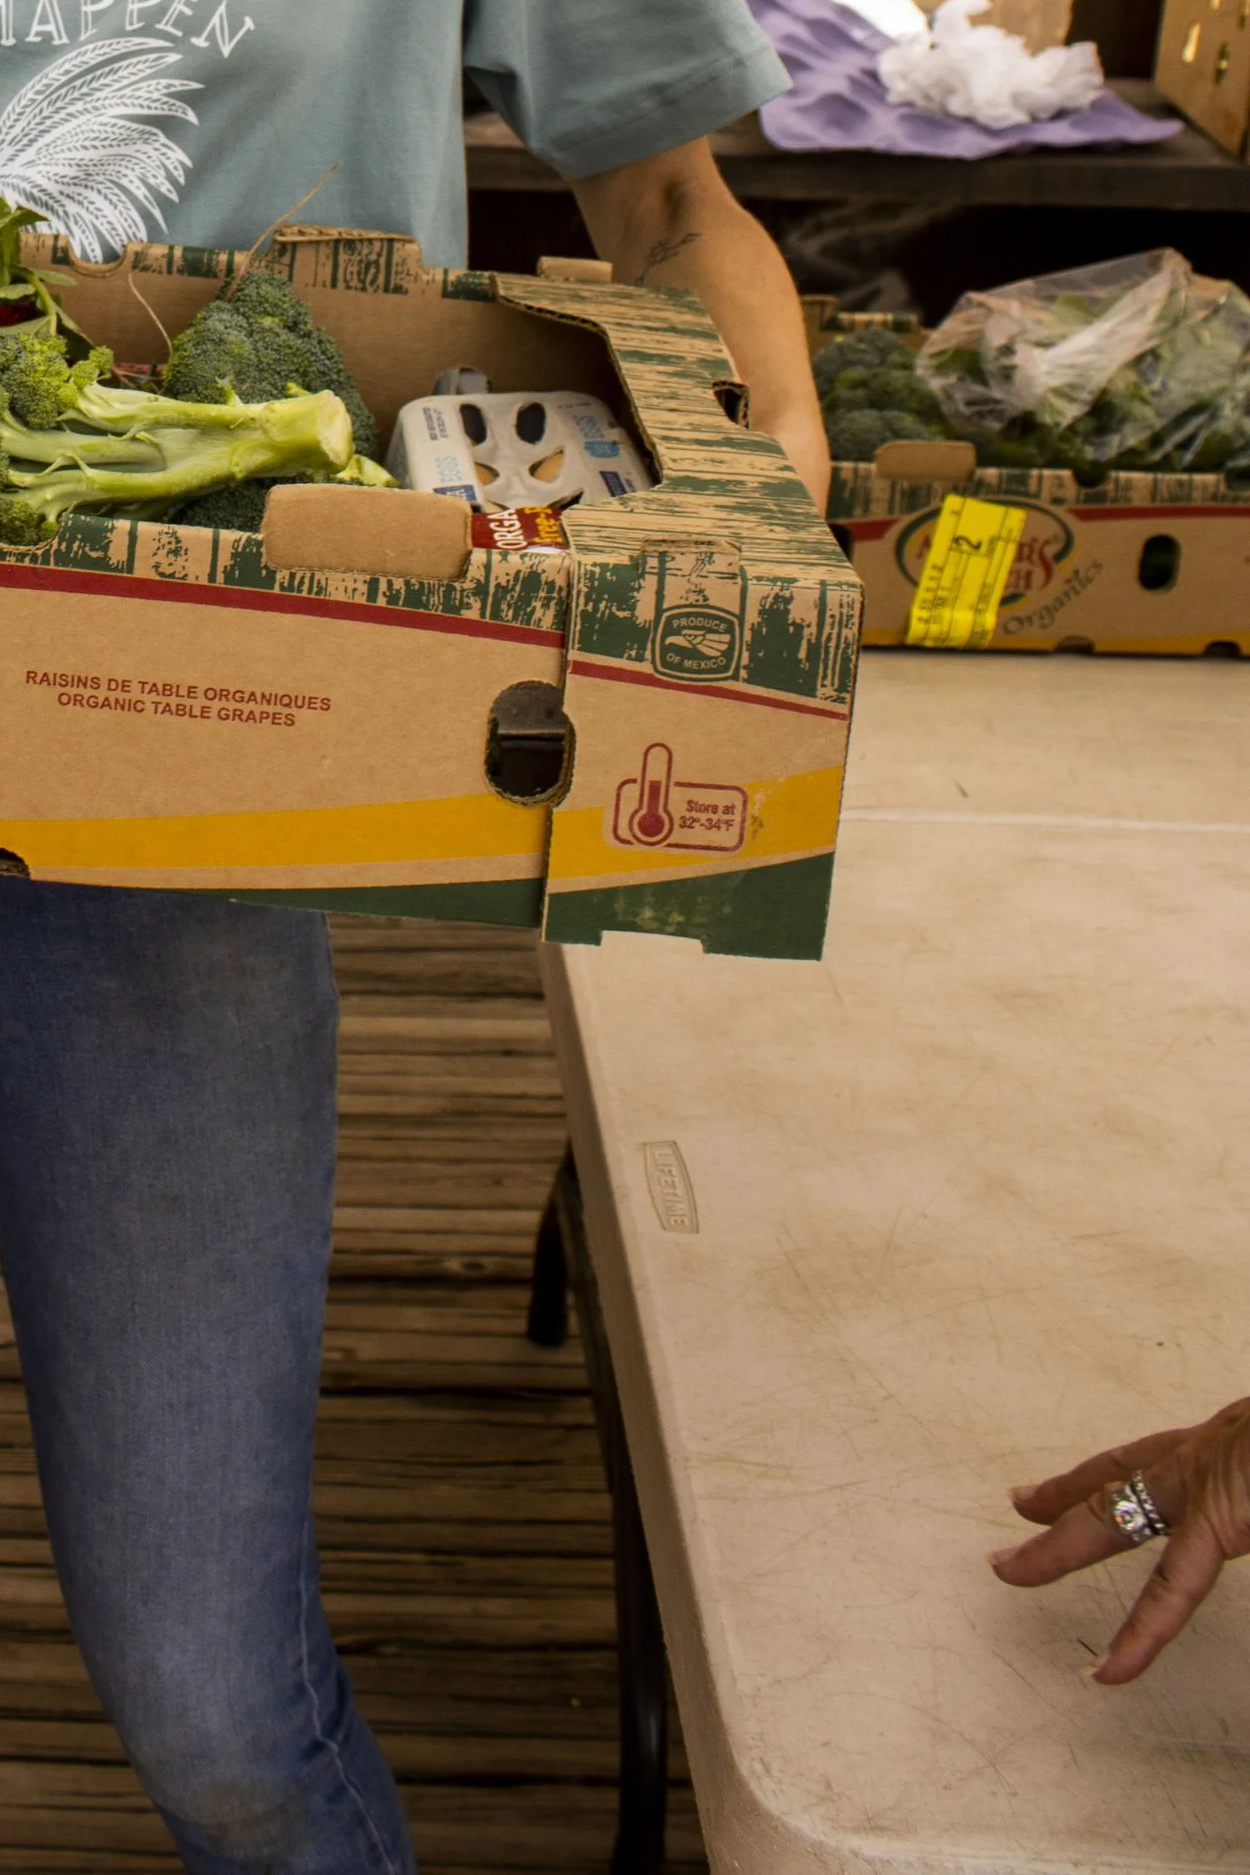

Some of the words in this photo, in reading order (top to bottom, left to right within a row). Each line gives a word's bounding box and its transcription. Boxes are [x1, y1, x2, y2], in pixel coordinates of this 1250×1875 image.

[672, 617, 727, 632] PRODUCE
[666, 653, 681, 664] OF
[683, 657, 726, 669] MEXICO
[25, 670, 100, 691] RAISINS
[107, 677, 132, 694] DE
[138, 681, 198, 701] TABLE
[203, 686, 331, 712] ORGANIQUES
[57, 692, 145, 714] ORGANIC
[151, 700, 212, 720] TABLE
[217, 707, 296, 727] GRAPES
[686, 799, 719, 815] Store
[722, 803, 736, 815] at
[652, 1149, 688, 1226] LIFETIME
